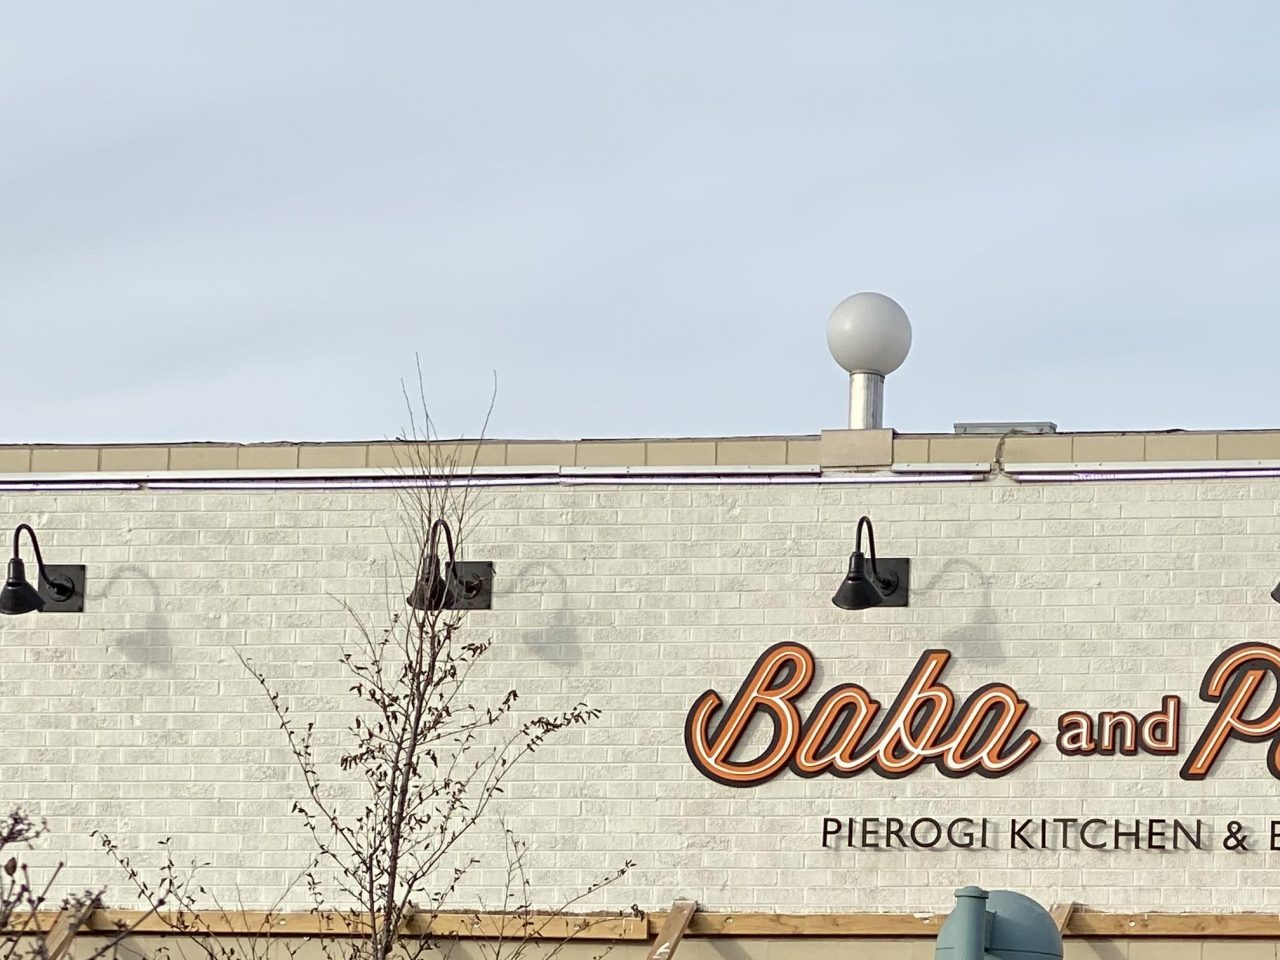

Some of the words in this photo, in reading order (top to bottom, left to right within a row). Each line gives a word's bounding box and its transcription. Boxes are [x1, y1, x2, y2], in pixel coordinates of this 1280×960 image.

[685, 641, 1040, 787] Baba
[1056, 695, 1181, 756] and
[822, 818, 989, 850] PIEROGI
[1010, 818, 1202, 851] KITCHEN
[1223, 819, 1250, 851] &
